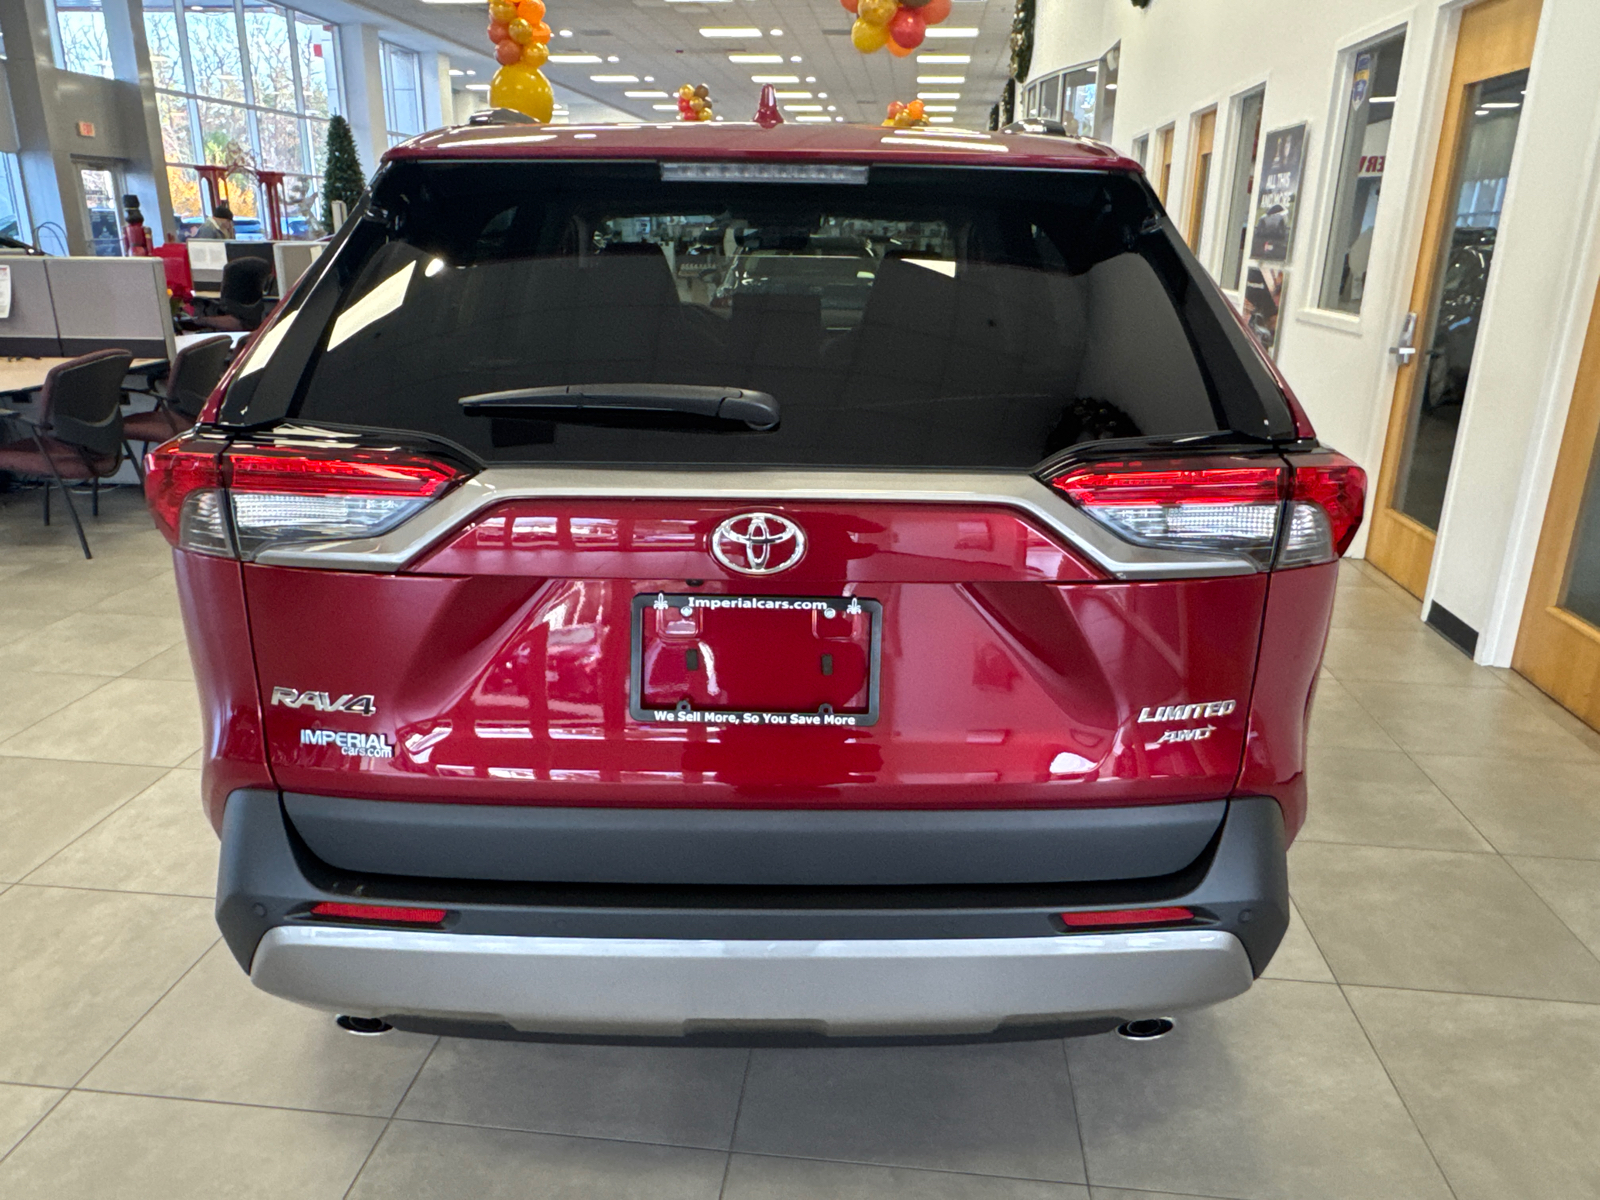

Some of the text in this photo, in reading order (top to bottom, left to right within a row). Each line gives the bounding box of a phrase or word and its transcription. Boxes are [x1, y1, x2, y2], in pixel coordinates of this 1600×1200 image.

[688, 596, 828, 611] Imperialcars.com
[270, 686, 377, 717] RAV4
[654, 710, 856, 726] We Sell More, So You Save More
[1137, 699, 1236, 723] LIMITED
[300, 728, 392, 751] IMPERIAL
[1156, 727, 1212, 744] AWD
[341, 746, 392, 758] cars.com
